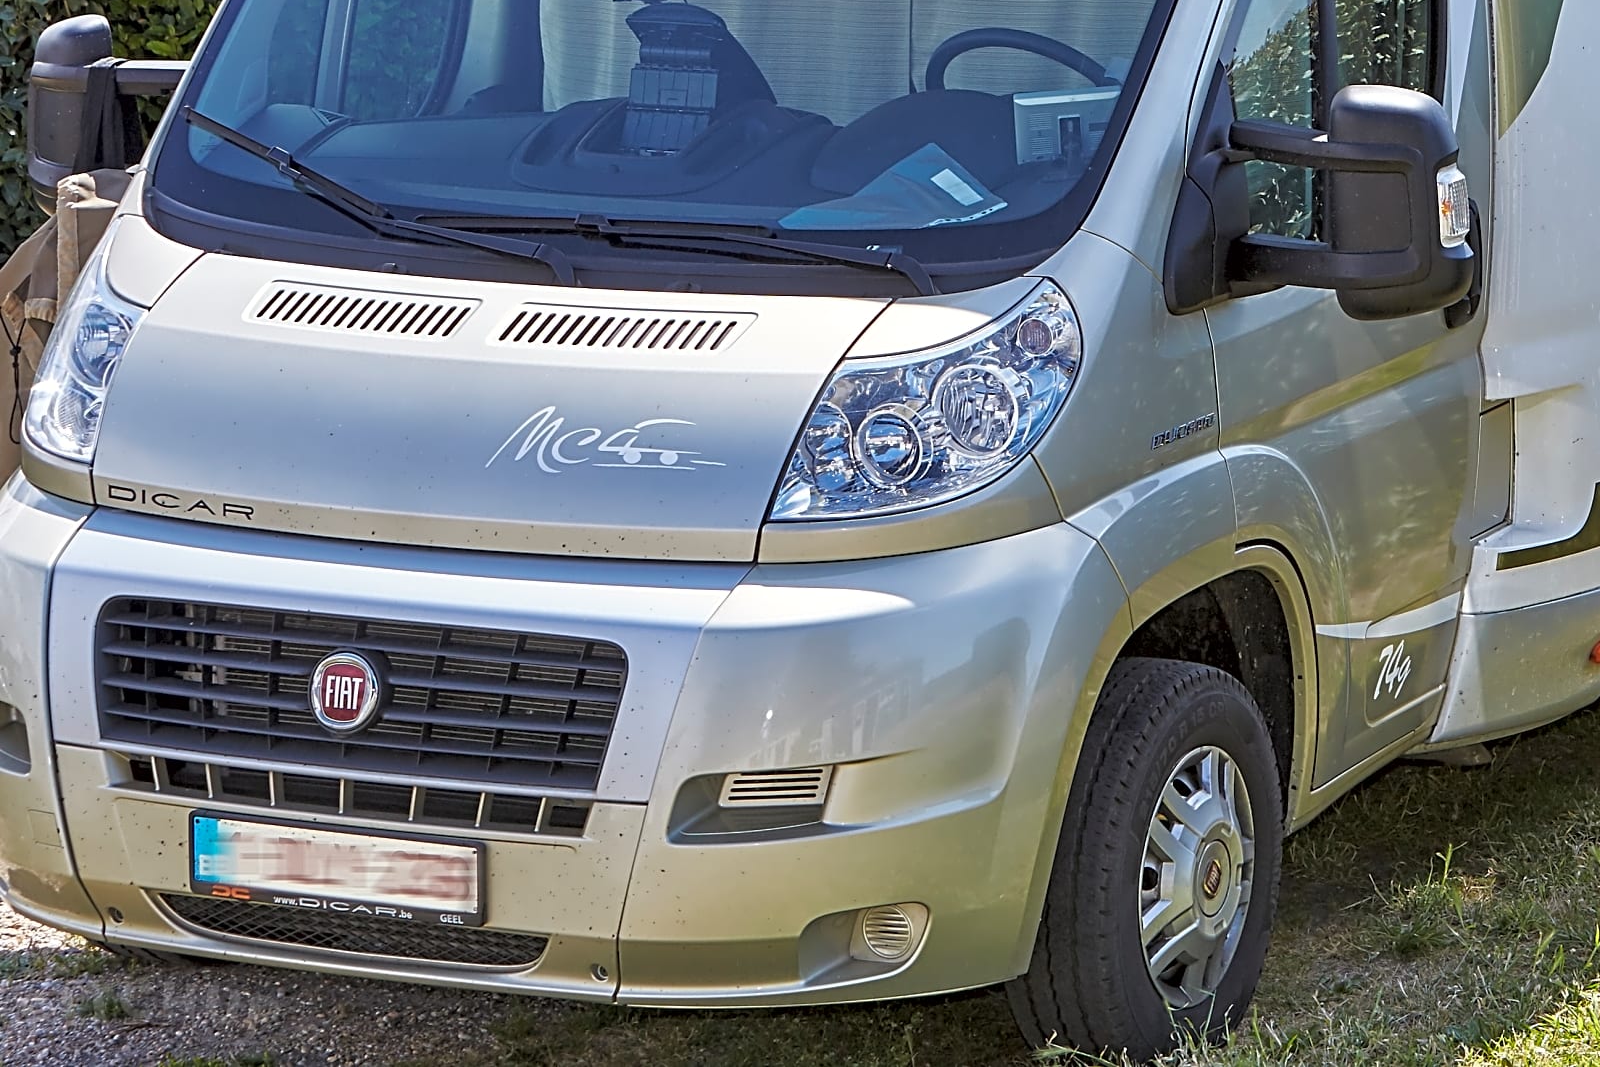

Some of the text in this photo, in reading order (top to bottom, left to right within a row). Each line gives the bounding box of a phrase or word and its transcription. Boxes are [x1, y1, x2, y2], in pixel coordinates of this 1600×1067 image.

[108, 484, 254, 521] DICAR
[325, 675, 364, 710] FIAT
[440, 913, 464, 925] GEEL
